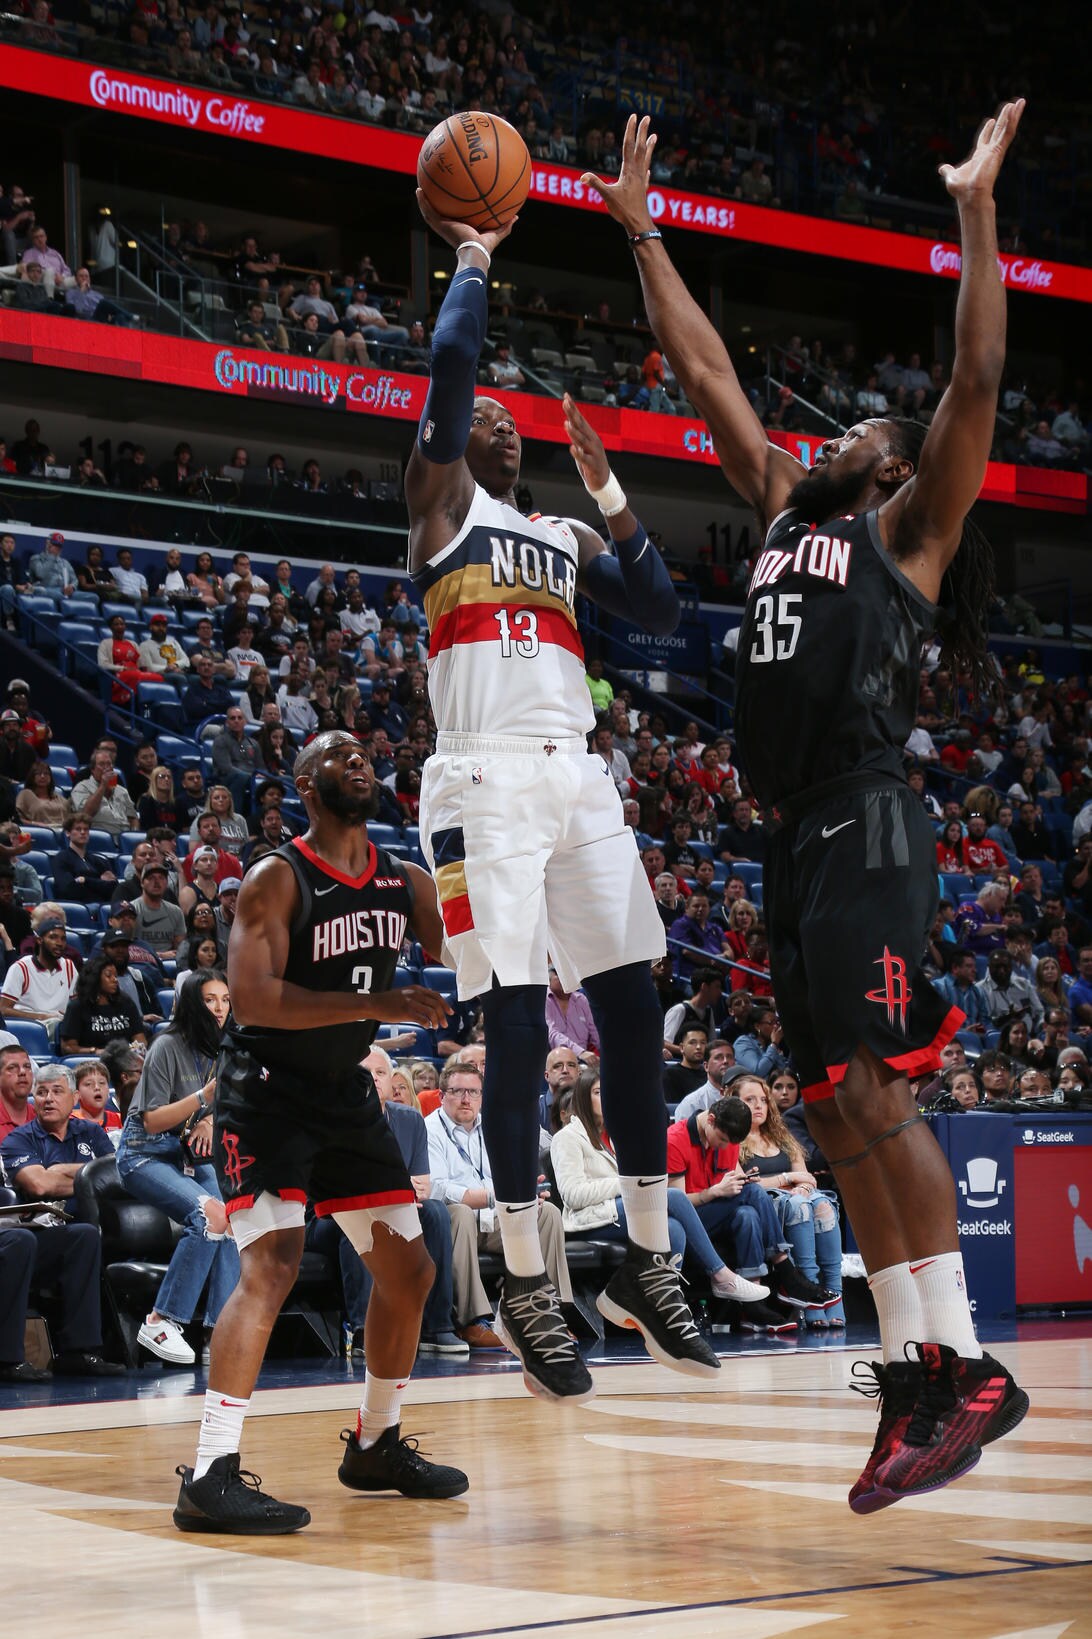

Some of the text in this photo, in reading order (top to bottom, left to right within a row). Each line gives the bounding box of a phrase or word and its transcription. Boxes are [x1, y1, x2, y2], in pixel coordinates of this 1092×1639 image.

[89, 70, 265, 133] Community Coffee
[530, 170, 584, 200] EERS
[669, 199, 735, 229] YEARS!
[1010, 260, 1053, 288] Coffee
[214, 349, 412, 409] Community Coffee
[706, 521, 750, 563] 114
[747, 534, 852, 599] HOUTON
[489, 536, 577, 613] NOLA
[494, 608, 540, 659] 13
[628, 633, 687, 649] GREY GOOSE
[750, 593, 803, 663] 35
[237, 653, 259, 662] NASA
[313, 910, 408, 962] HOUSTON
[1036, 1131, 1074, 1143] SeatGeek
[957, 1219, 1012, 1236] SeatGeek
